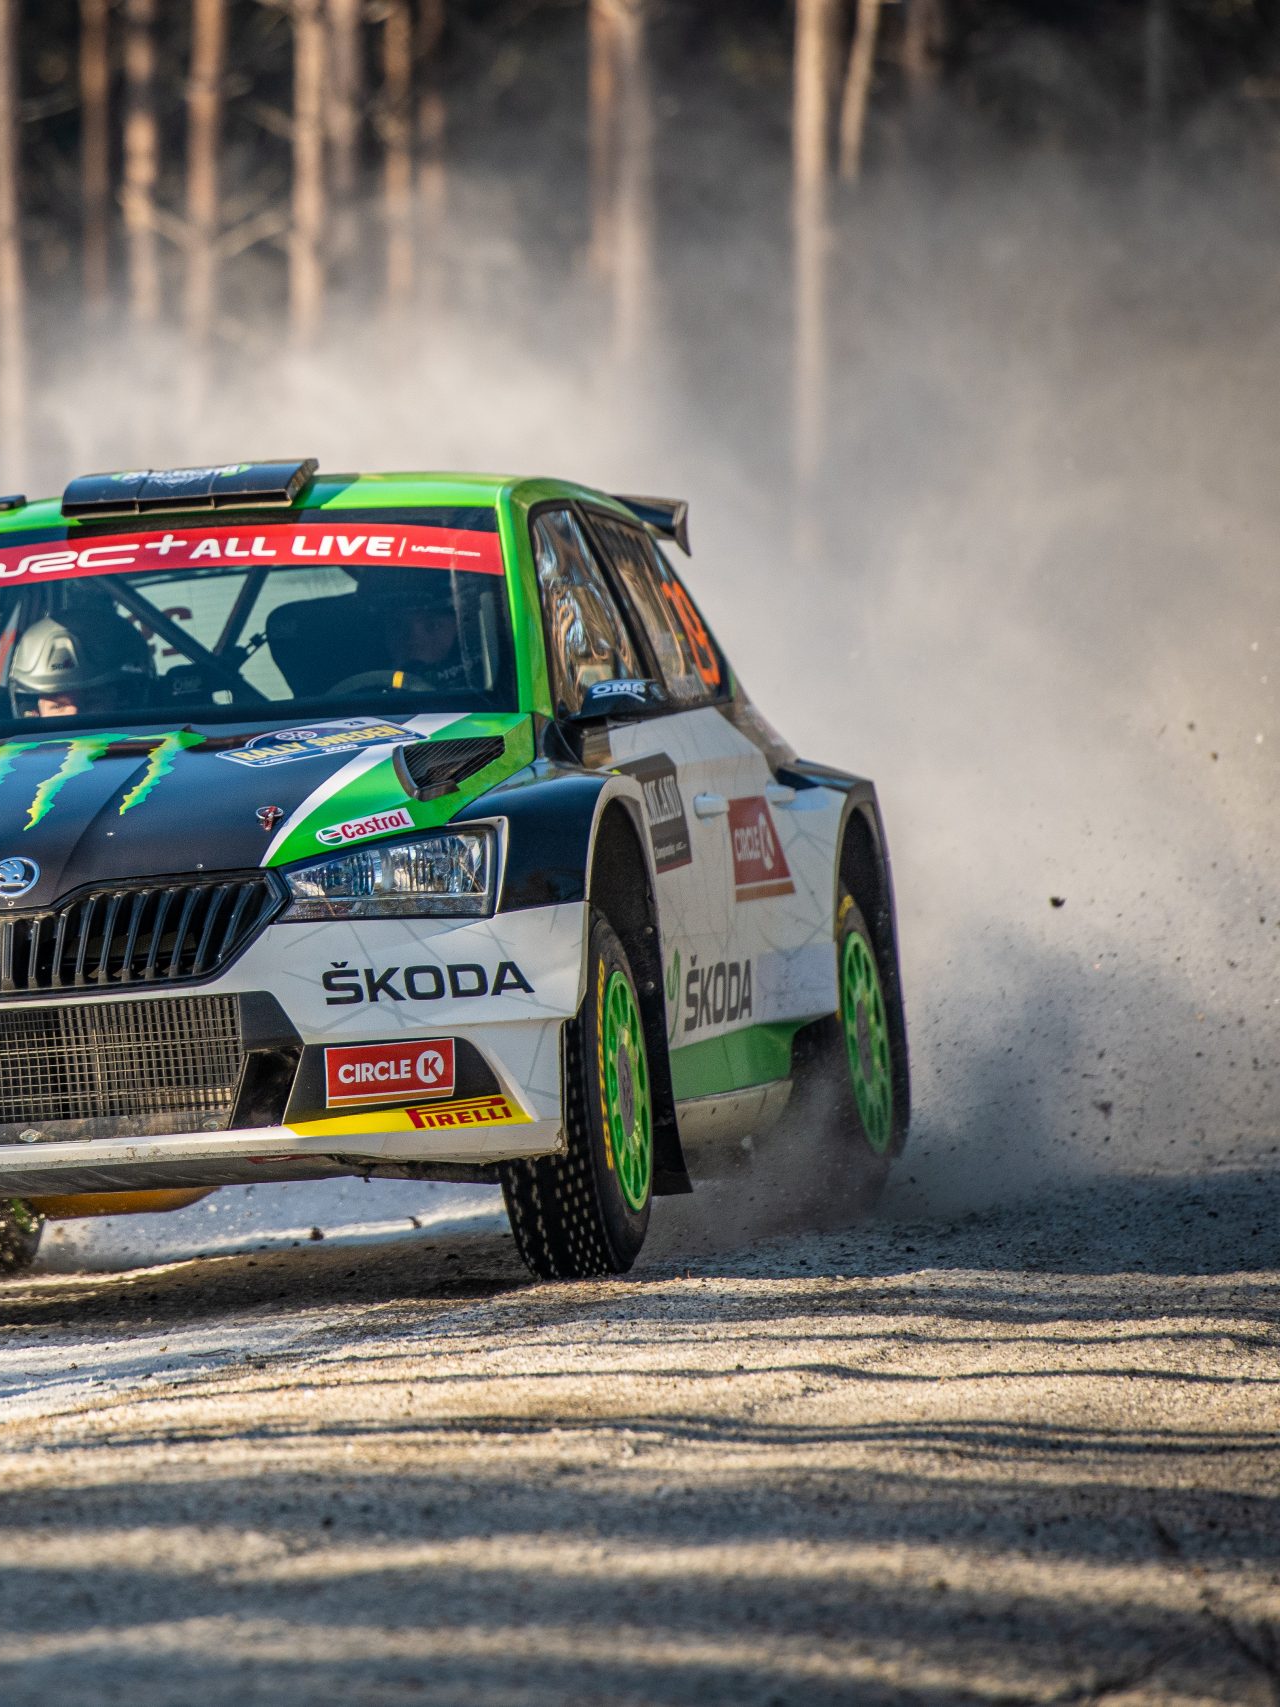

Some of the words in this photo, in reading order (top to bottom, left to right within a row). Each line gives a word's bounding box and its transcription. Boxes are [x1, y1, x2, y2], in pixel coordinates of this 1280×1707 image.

[189, 536, 277, 560] ALL
[291, 535, 396, 557] LIVE
[592, 681, 646, 694] OMP
[230, 741, 309, 762] RALLY
[306, 725, 407, 748] SWEDEN
[340, 810, 410, 840] Castrol
[734, 826, 761, 862] CIRCLE
[322, 961, 535, 1006] ŠKODA
[684, 954, 752, 1032] ŠKODA
[338, 1058, 411, 1084] CIRCLE
[423, 1056, 444, 1077] K
[406, 1097, 513, 1129] PIRELLI
